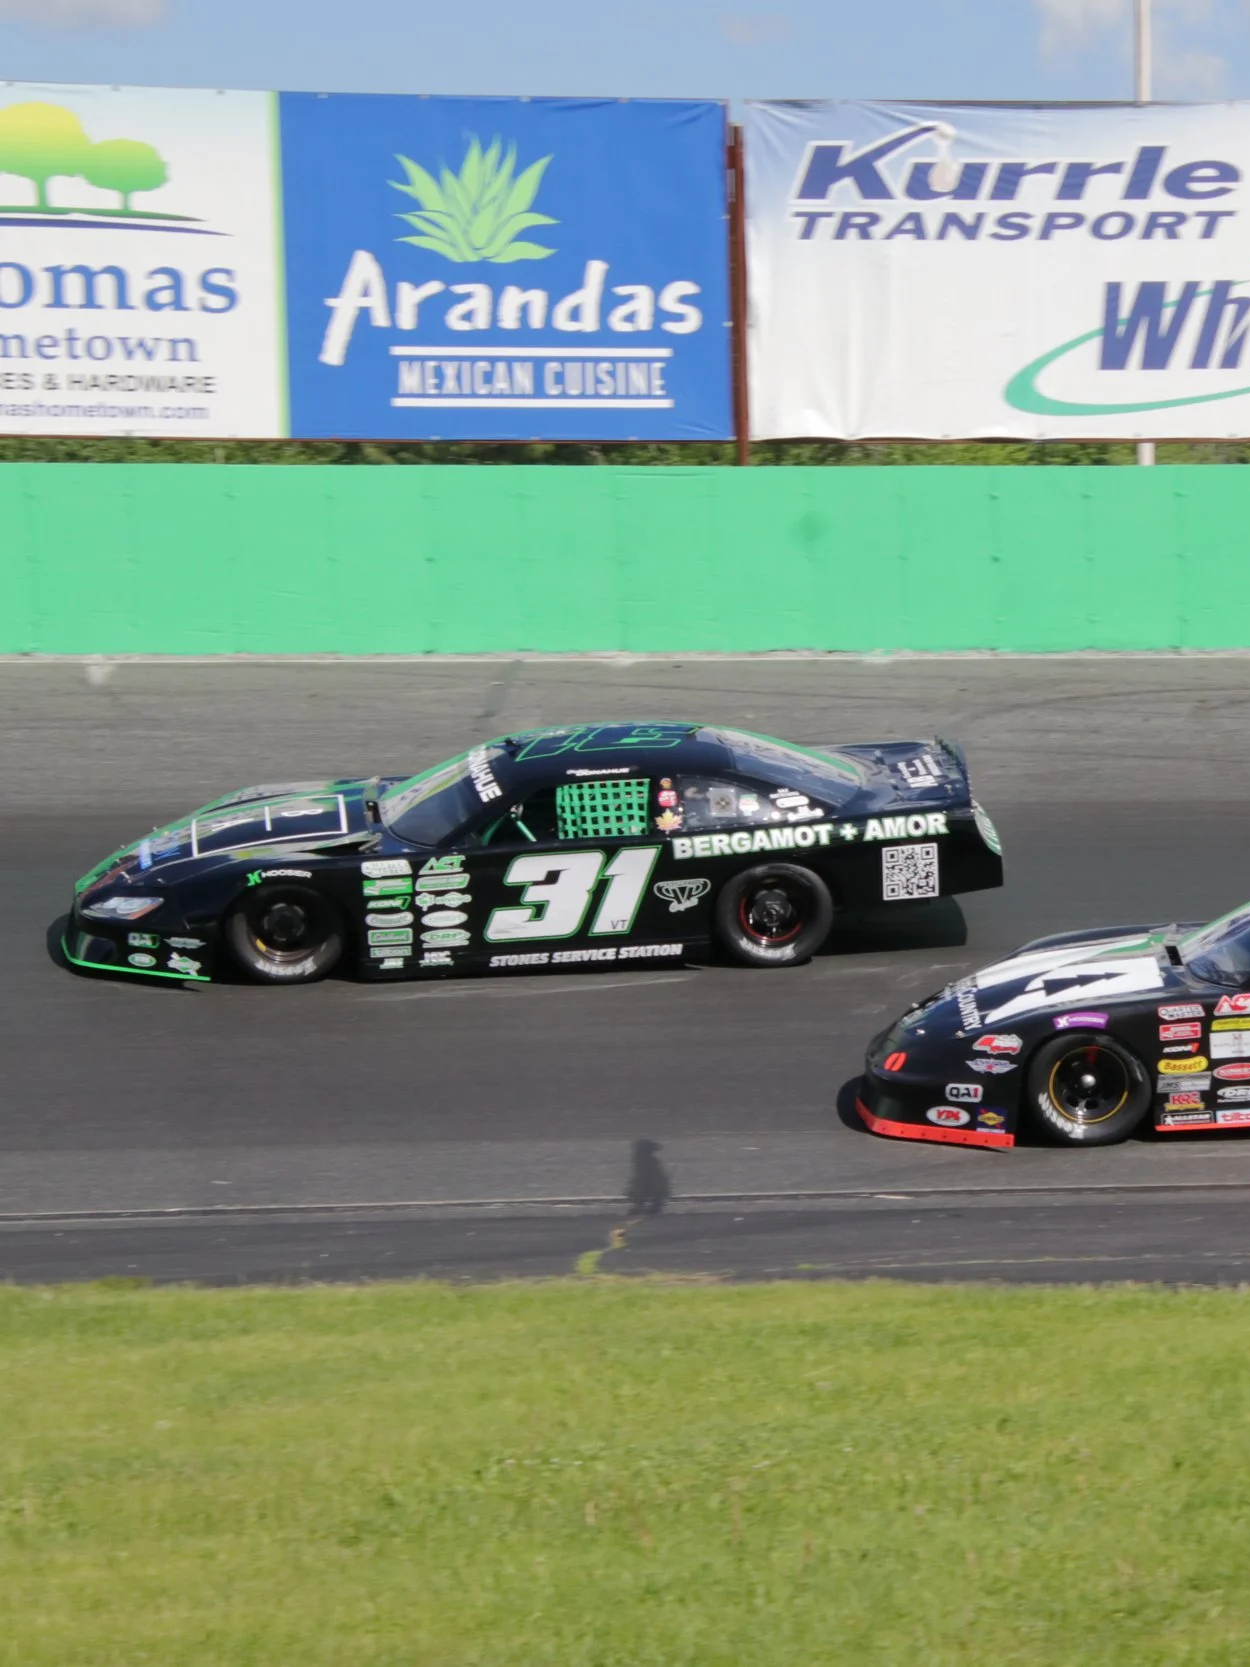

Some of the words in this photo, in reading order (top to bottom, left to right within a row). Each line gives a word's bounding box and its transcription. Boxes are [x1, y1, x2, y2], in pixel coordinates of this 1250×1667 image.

[796, 122, 1244, 202] Kurrle
[793, 209, 1238, 242] TRANSPORT
[318, 249, 703, 367] Arandas
[66, 374, 218, 394] HARDWARE
[398, 360, 534, 398] MEXICAN
[543, 361, 667, 398] CUISINE
[672, 823, 834, 861] BERGAMOT
[838, 824, 858, 842] +
[862, 812, 950, 842] AMOR
[261, 869, 313, 879] HOOSIER
[483, 844, 663, 942] 31
[610, 918, 628, 932] VT
[489, 952, 550, 968] STONES
[551, 947, 617, 964] SERVICE
[618, 943, 683, 960] STATION
[957, 986, 983, 1031] COUNTRY
[949, 1086, 980, 1099] QA1
